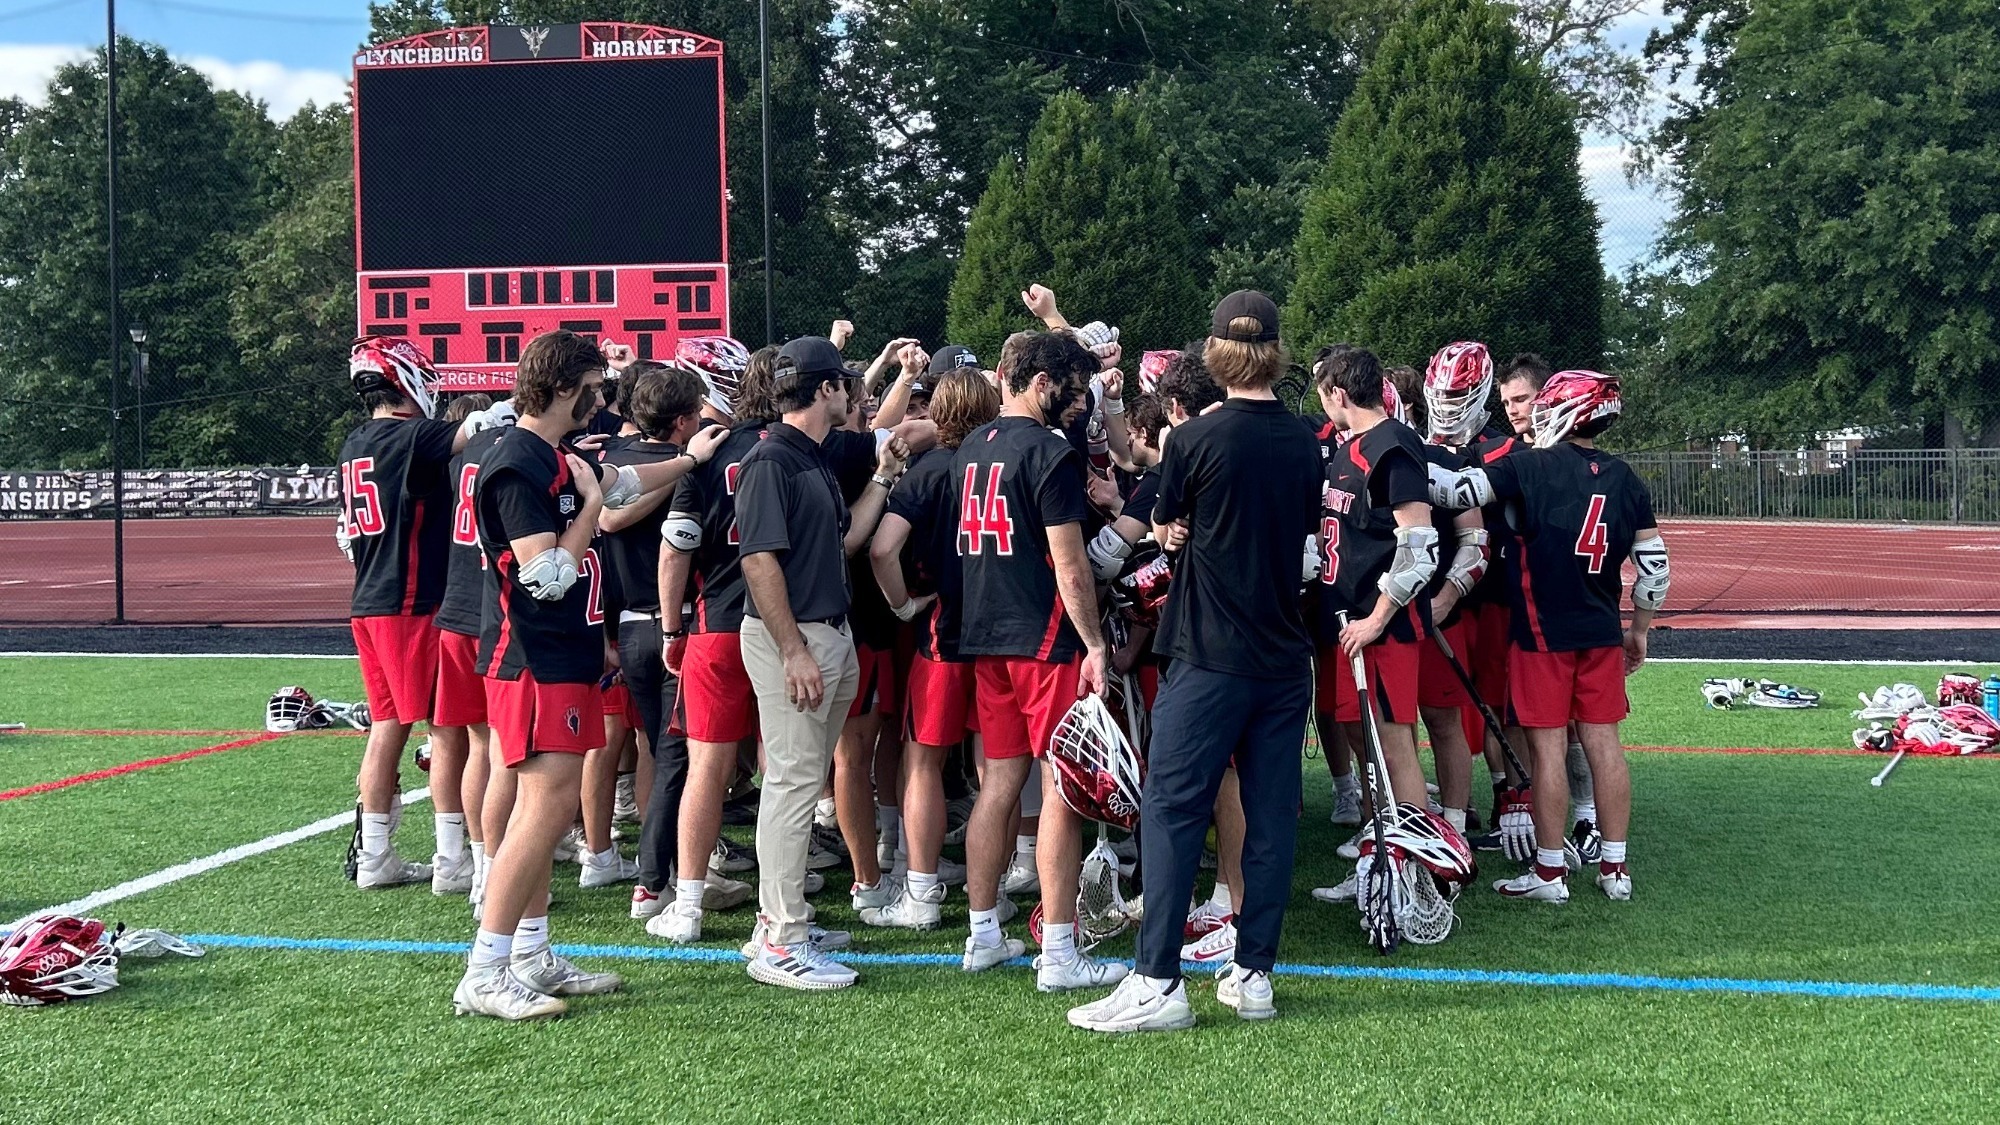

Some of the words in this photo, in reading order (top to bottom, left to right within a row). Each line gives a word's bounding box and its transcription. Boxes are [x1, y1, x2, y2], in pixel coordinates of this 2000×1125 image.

[366, 46, 483, 66] LYNCHBURG
[593, 38, 696, 59] HORNETS
[439, 372, 487, 385] ERGER
[18, 475, 28, 489] &
[35, 475, 75, 489] FIEL
[270, 477, 339, 499] LYNC
[0, 491, 92, 511] NSHIPS
[453, 463, 481, 546] 8
[961, 462, 1014, 556] 44
[674, 529, 698, 543] STX
[1574, 494, 1609, 573] 4
[1322, 517, 1340, 584] 3
[1366, 762, 1378, 792] STX
[1370, 844, 1396, 854] SX
